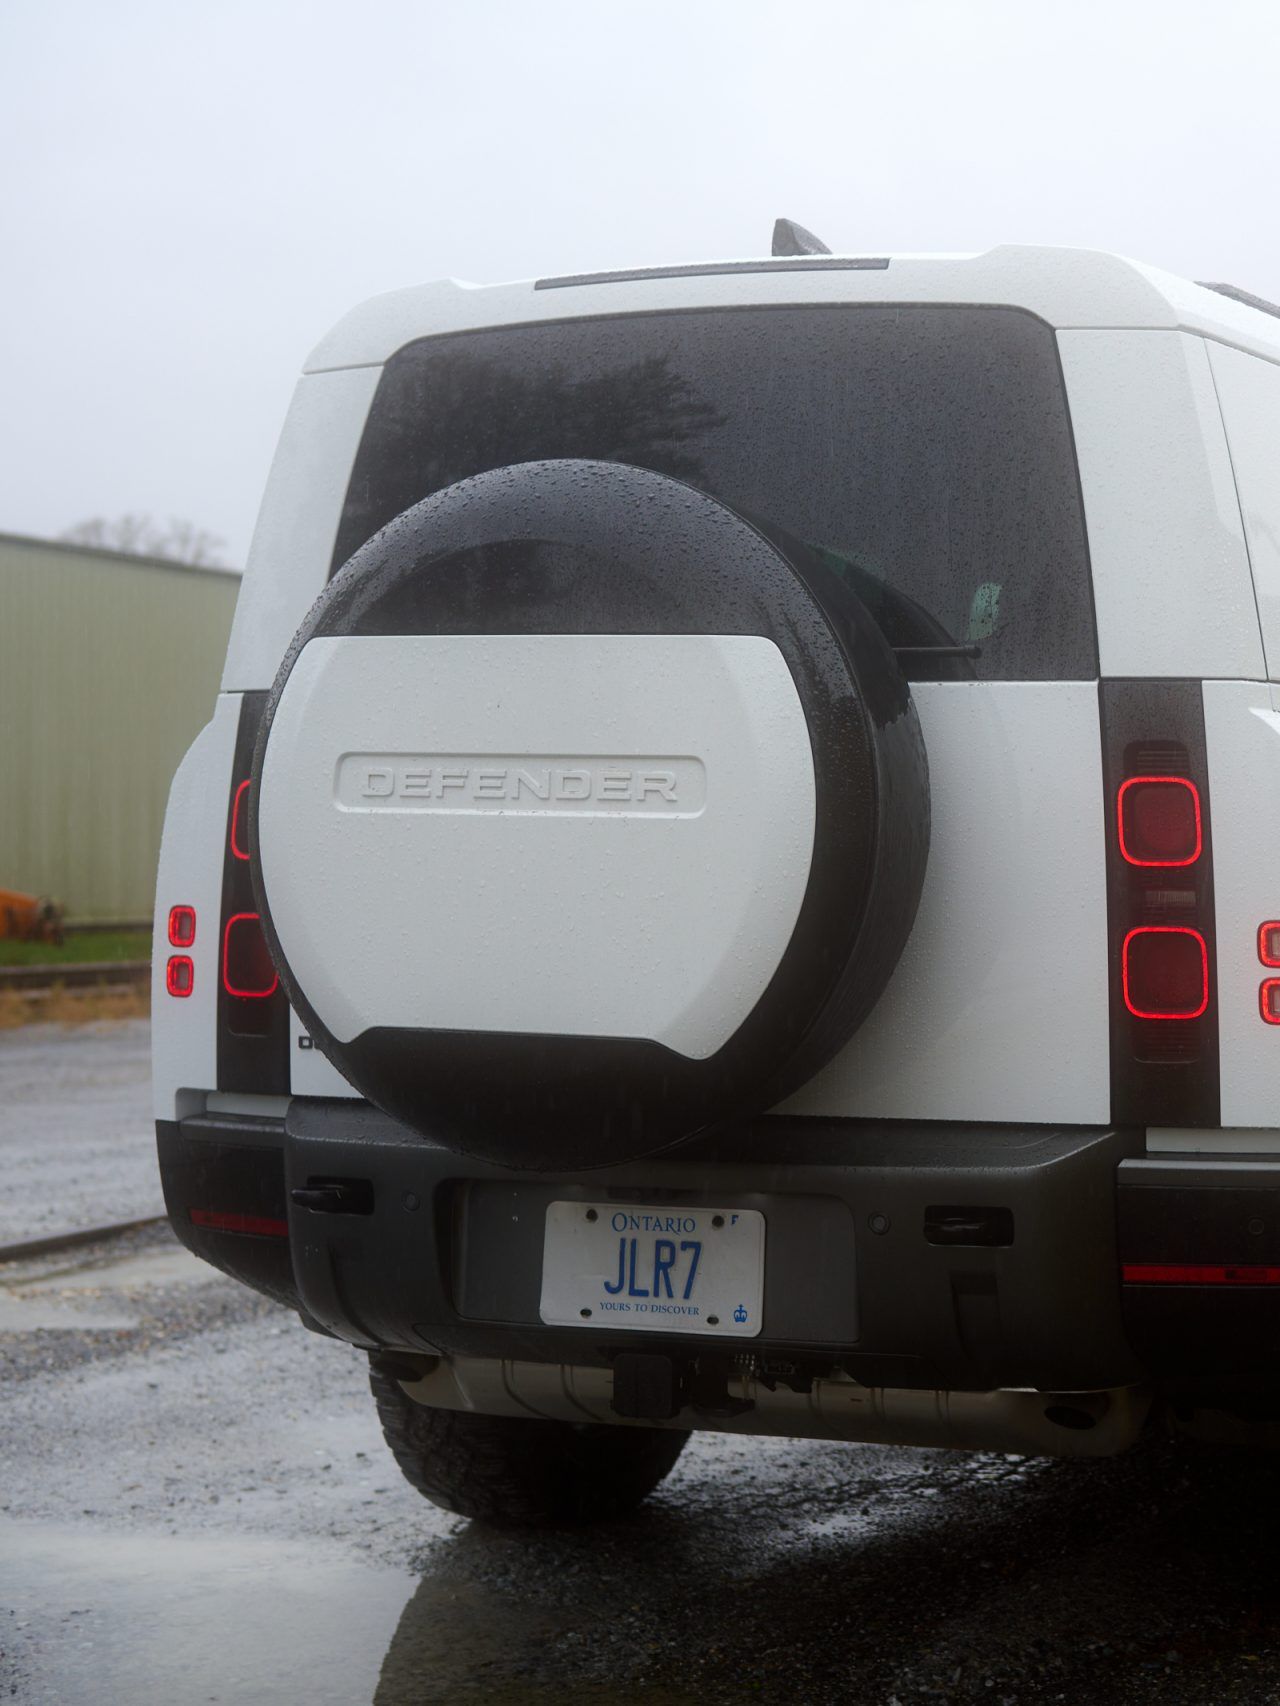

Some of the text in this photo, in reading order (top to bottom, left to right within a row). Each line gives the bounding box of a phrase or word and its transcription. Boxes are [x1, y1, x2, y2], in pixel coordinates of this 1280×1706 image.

[361, 767, 679, 802] DEFENDER
[603, 1237, 702, 1300] JLR7
[600, 1302, 700, 1316] YOURS TO DISCOVER
